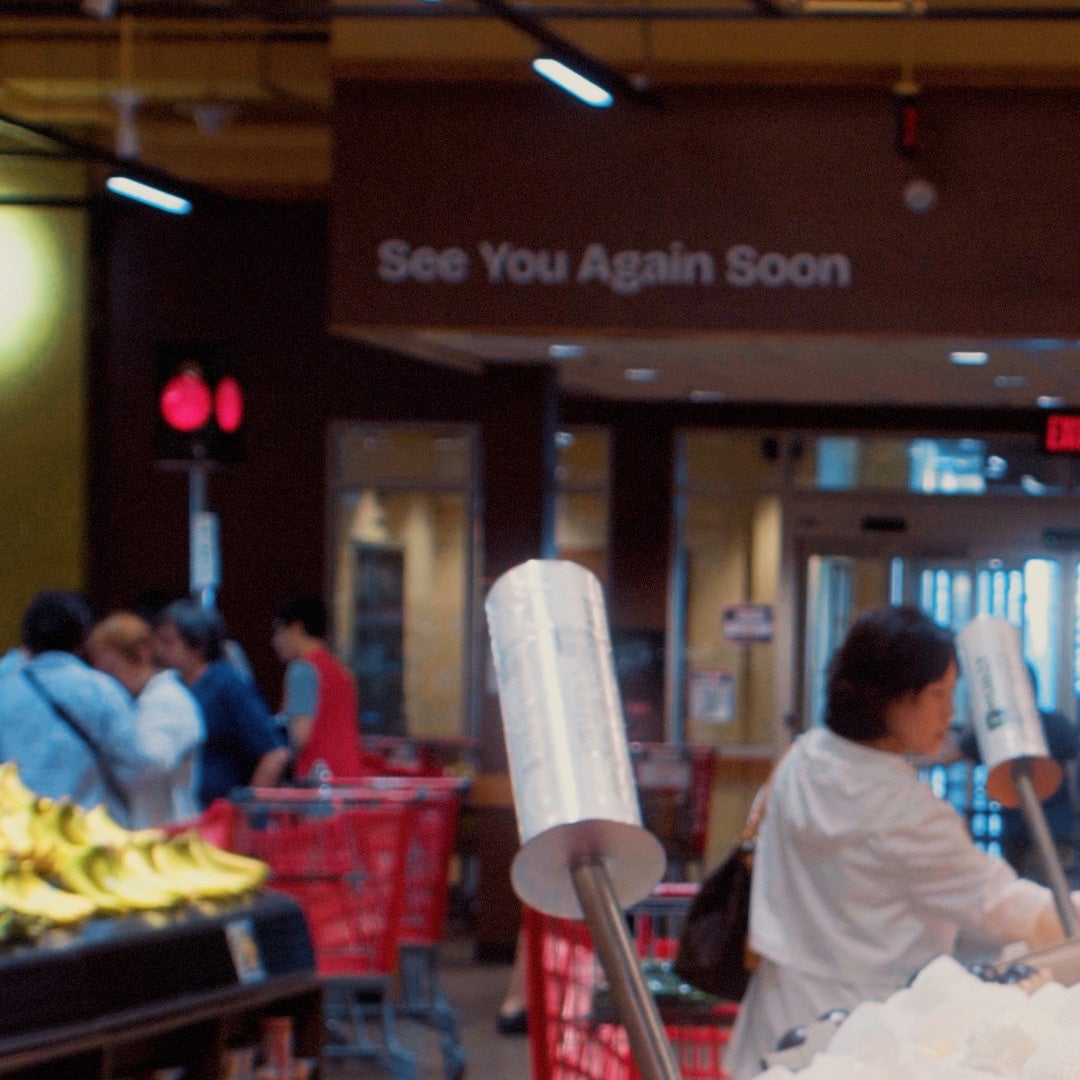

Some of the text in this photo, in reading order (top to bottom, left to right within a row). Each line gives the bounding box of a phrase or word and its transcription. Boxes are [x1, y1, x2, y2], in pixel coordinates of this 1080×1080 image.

[376, 239, 853, 295] See You Again Soon
